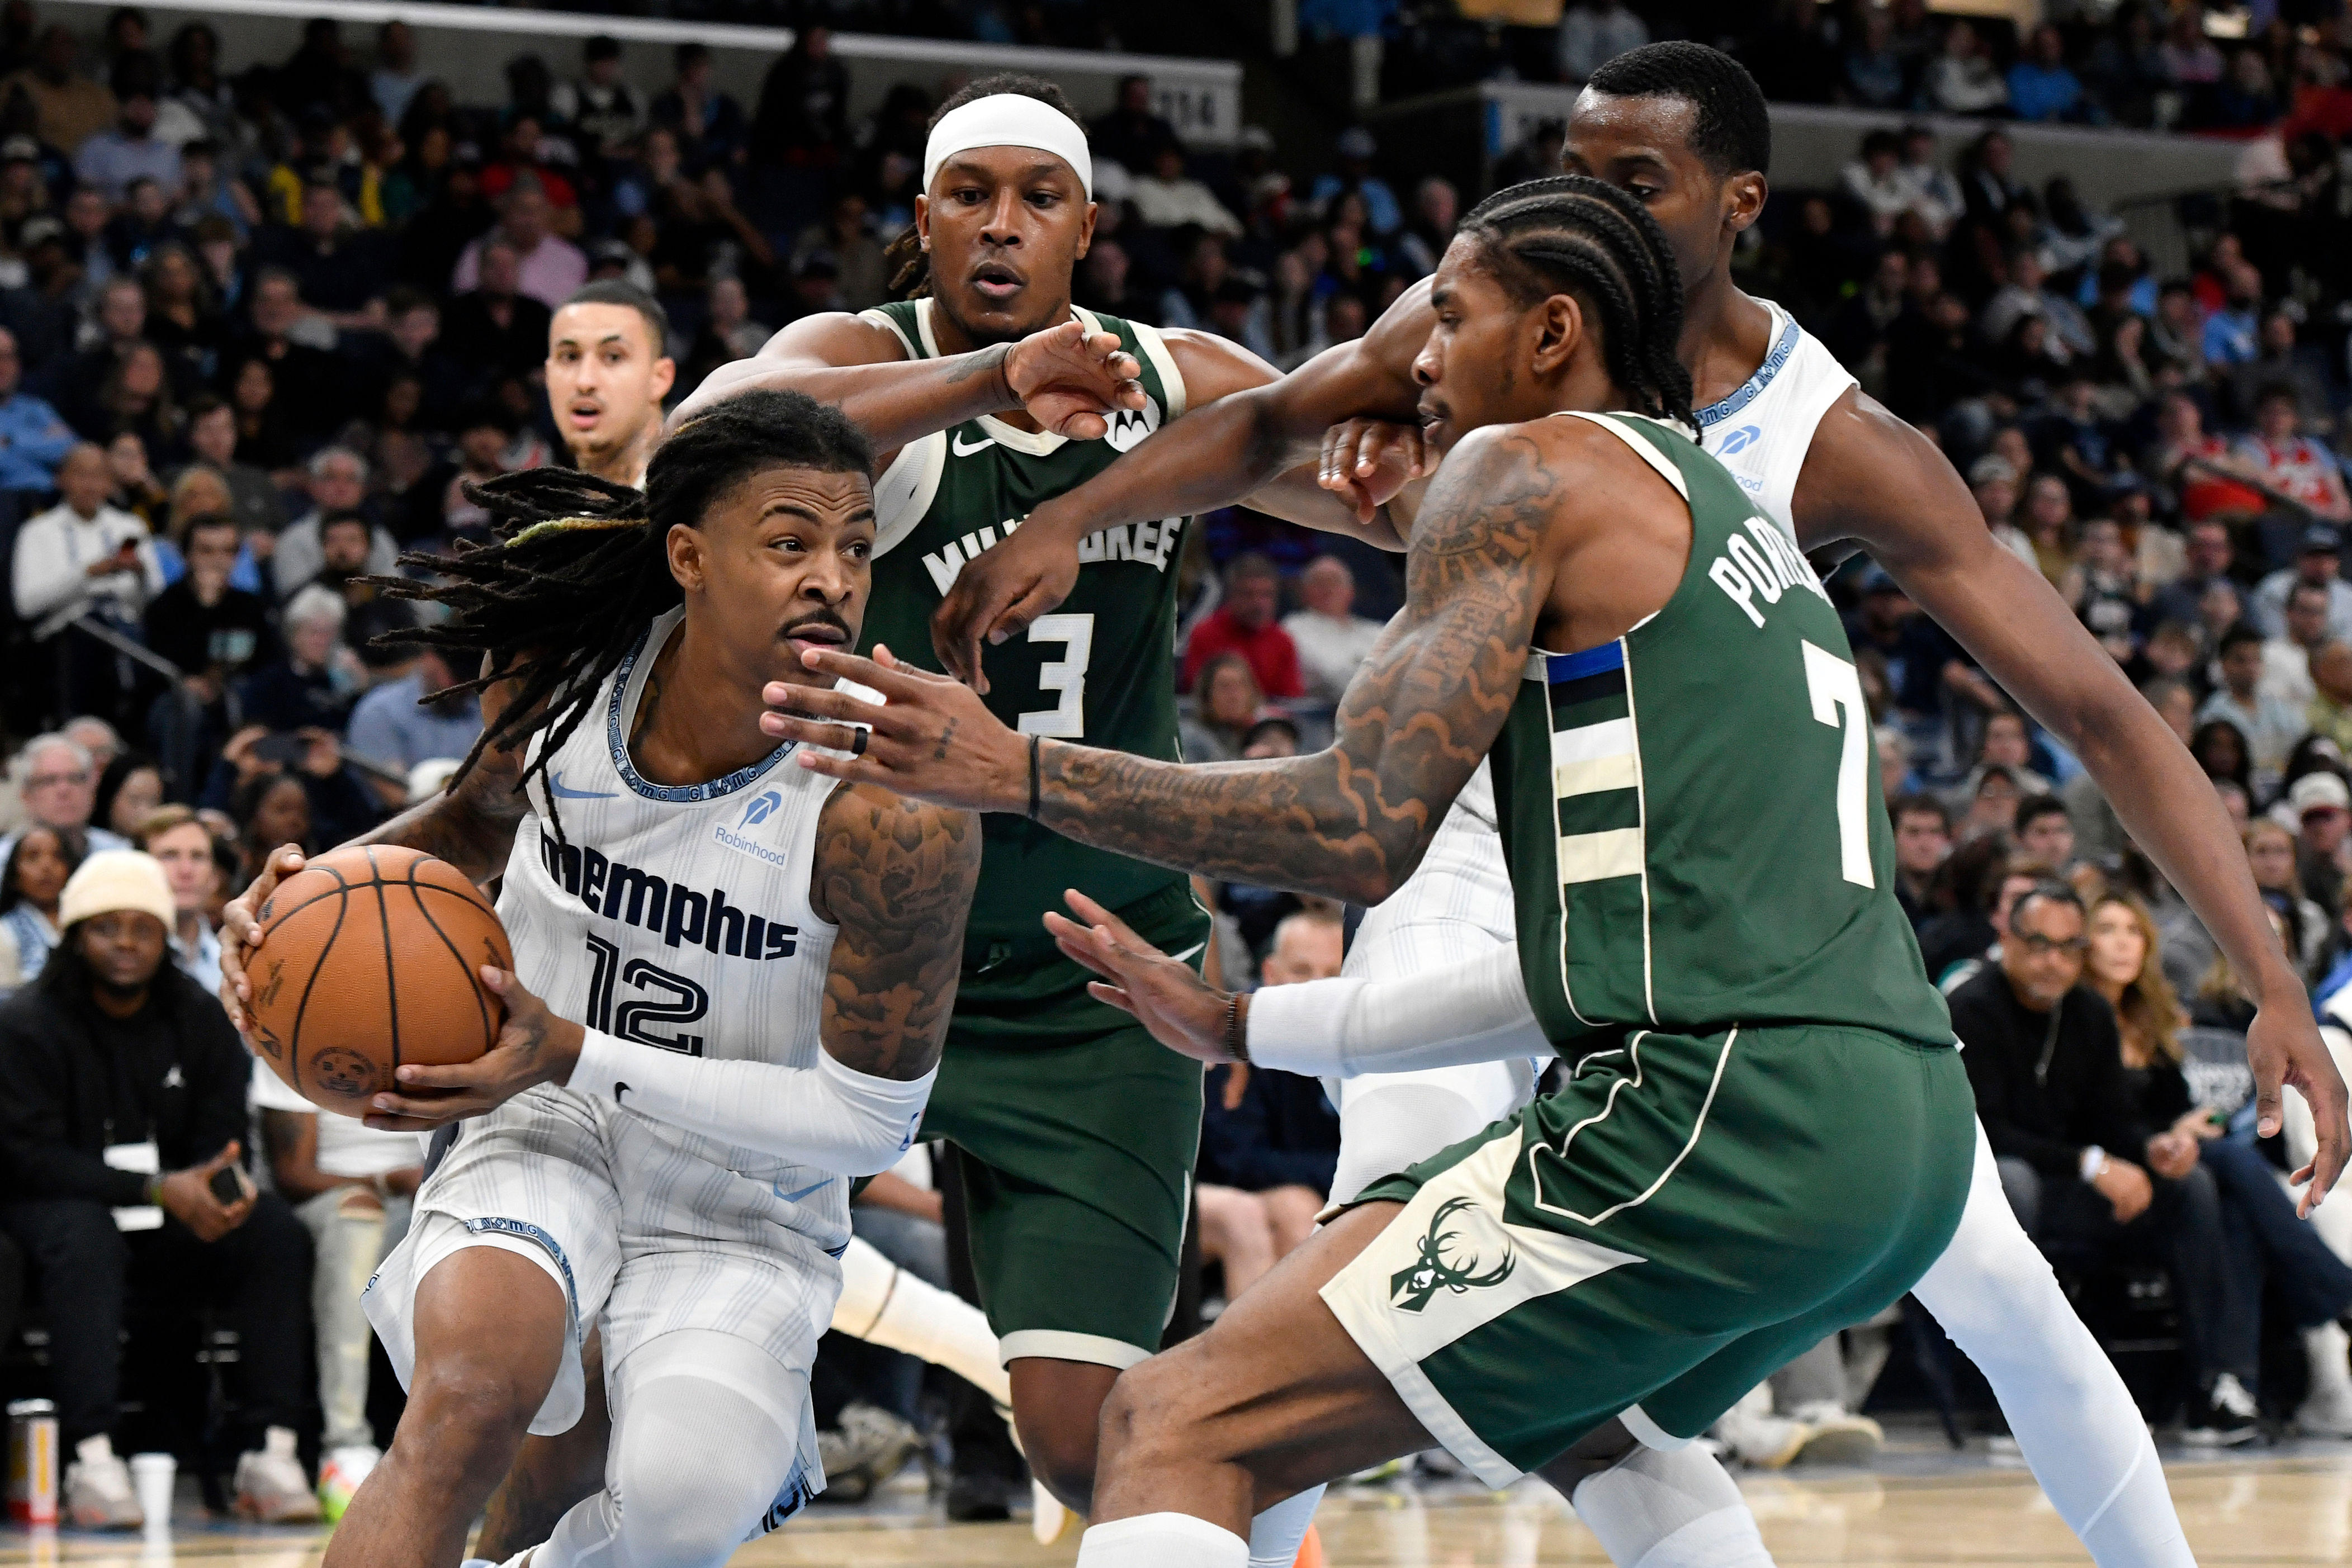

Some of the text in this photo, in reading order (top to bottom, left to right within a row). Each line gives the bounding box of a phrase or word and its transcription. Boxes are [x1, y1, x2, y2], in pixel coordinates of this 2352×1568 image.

[1017, 613, 1095, 738] 3
[1801, 638, 1876, 889] 7
[715, 826, 785, 866] Robinhood
[586, 930, 709, 1058] 12
